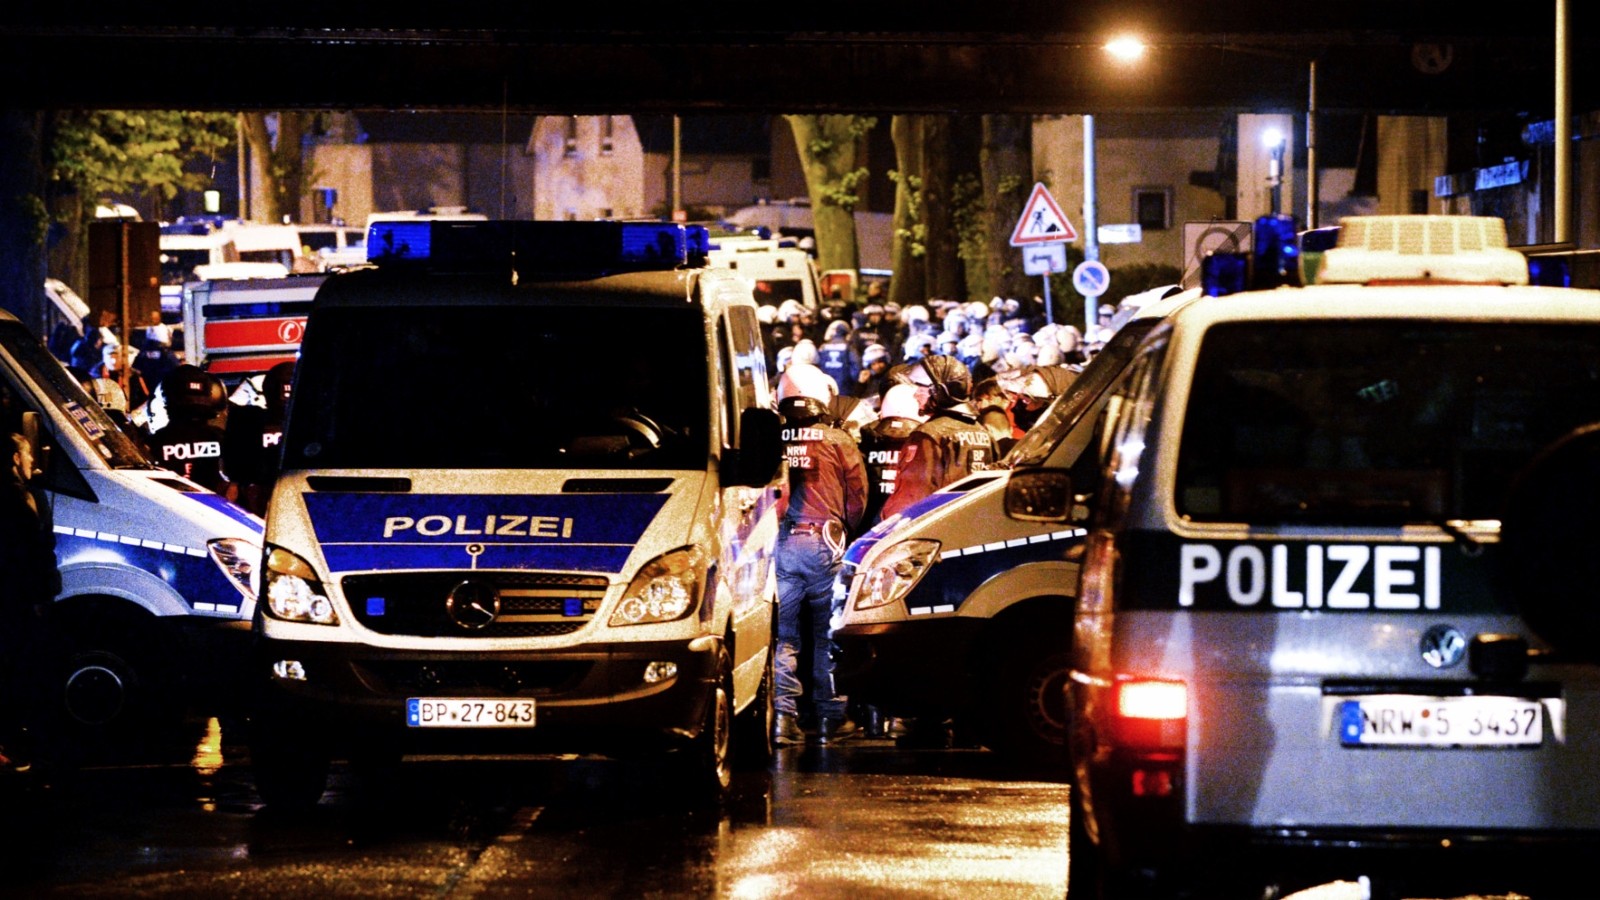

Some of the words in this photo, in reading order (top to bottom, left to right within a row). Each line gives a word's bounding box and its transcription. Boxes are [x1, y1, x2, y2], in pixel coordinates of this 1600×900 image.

[162, 441, 221, 461] POLIZEI
[786, 445, 808, 457] NRW
[382, 514, 574, 539] POLIZEI
[1177, 543, 1442, 610] POLIZEI
